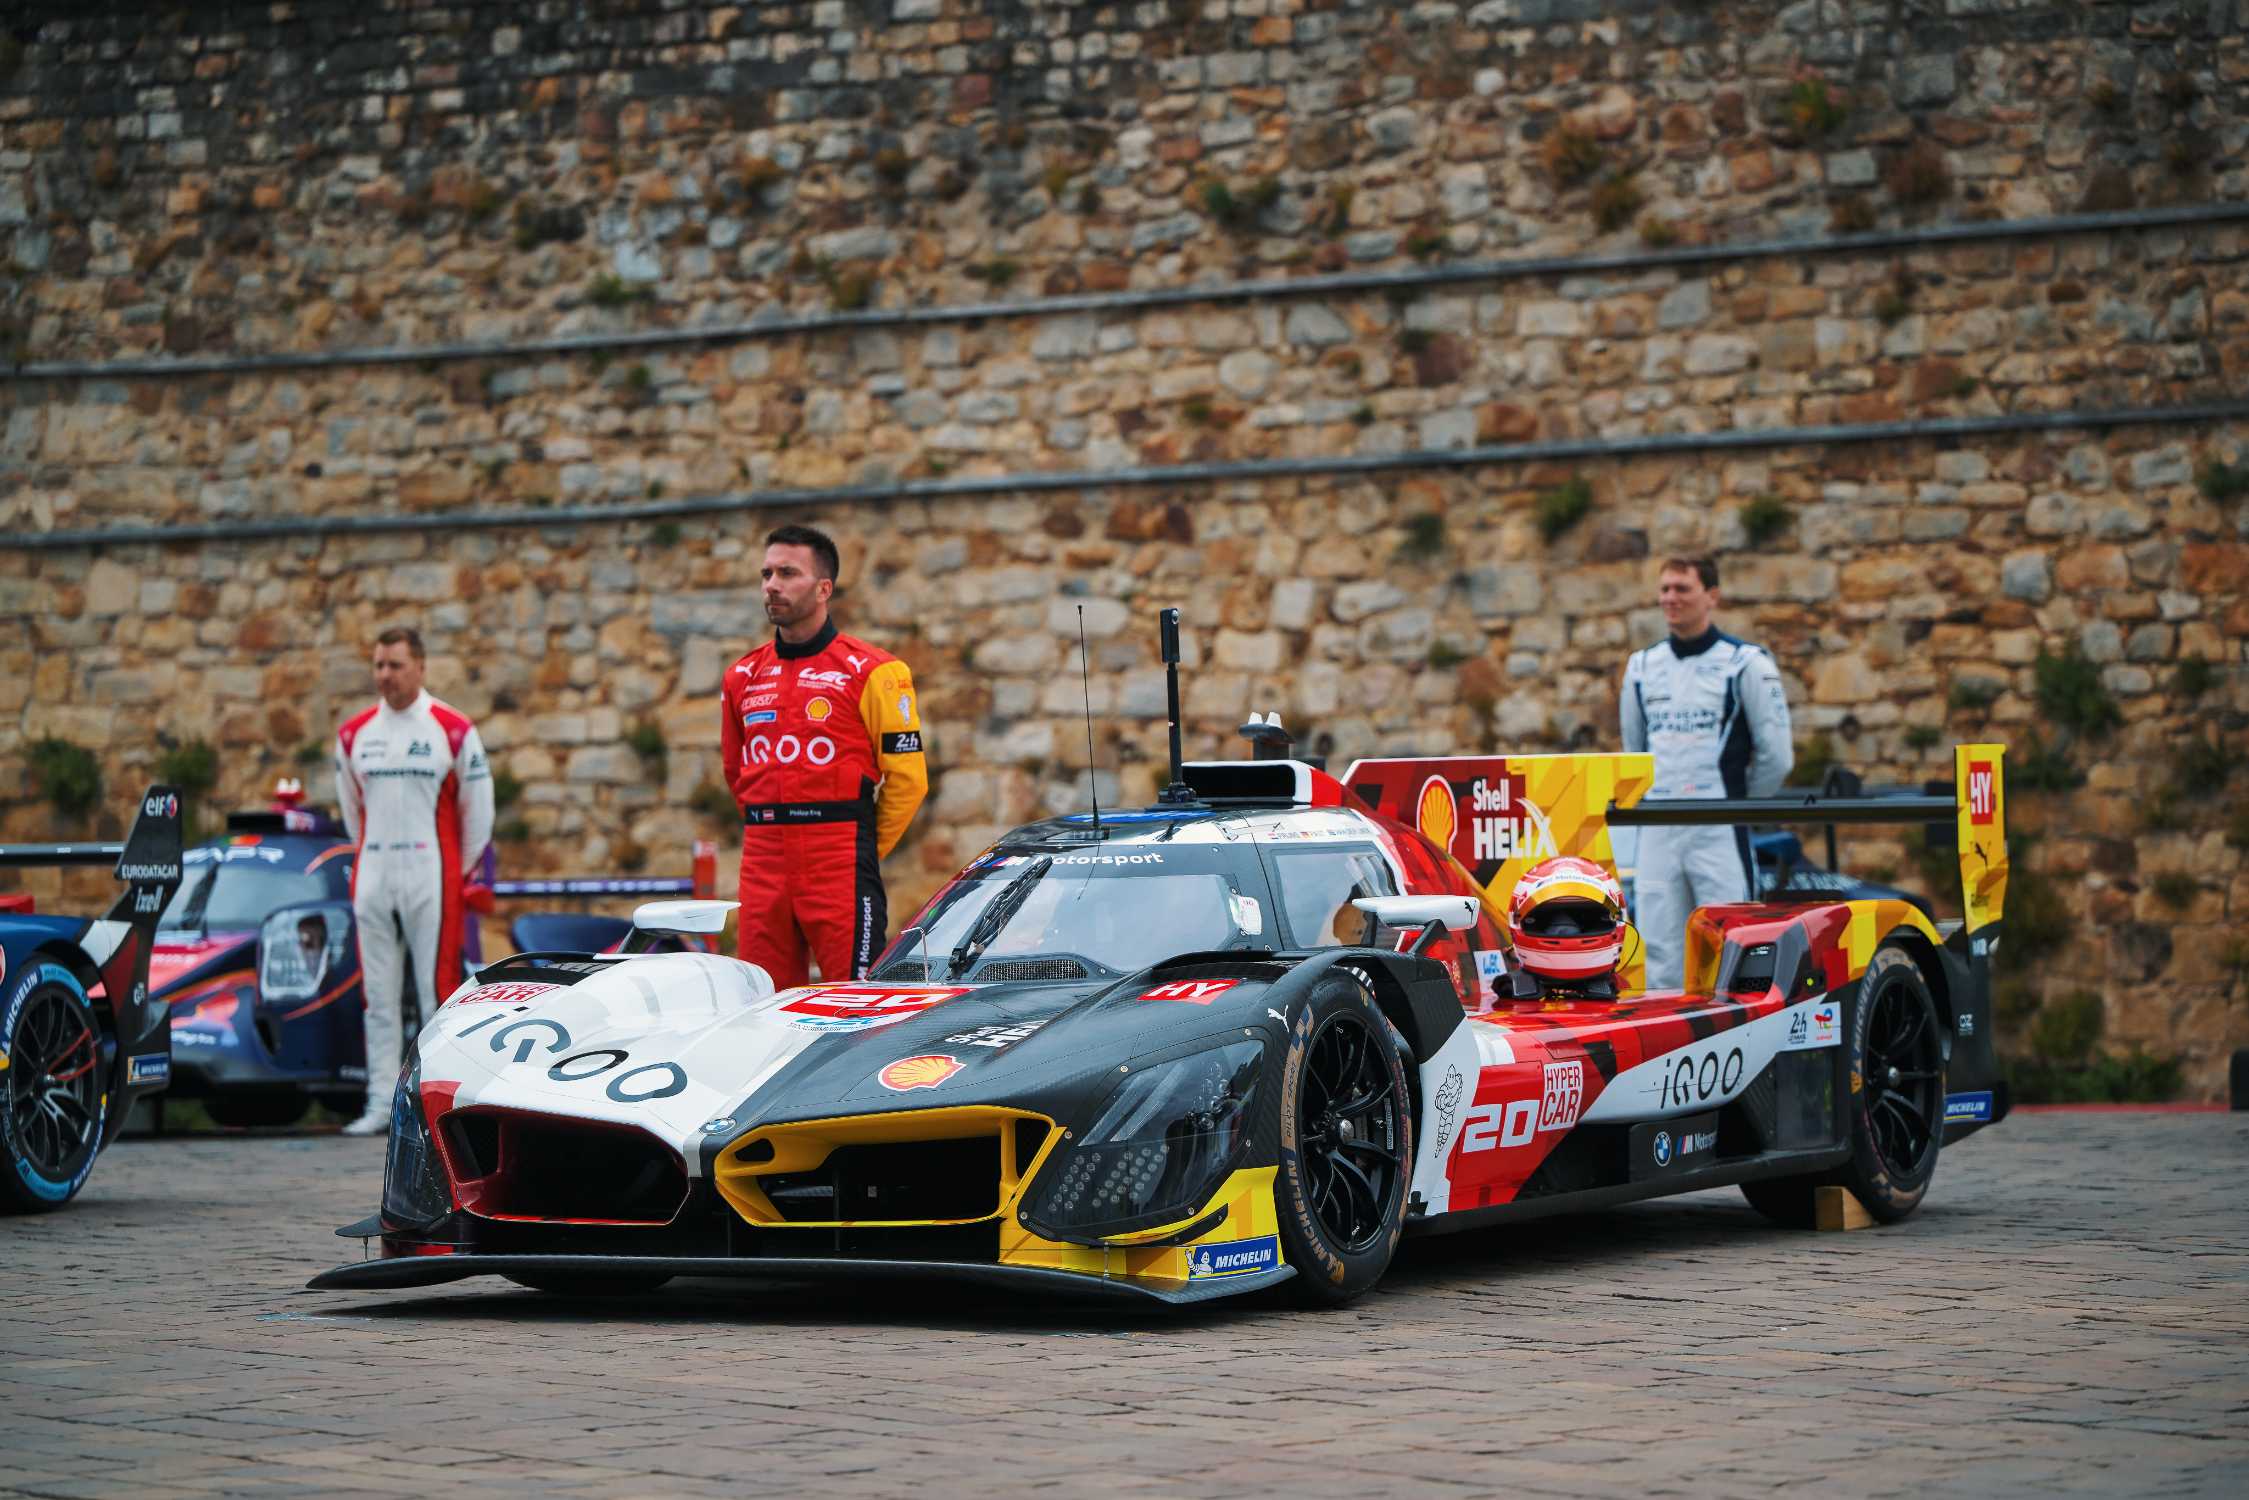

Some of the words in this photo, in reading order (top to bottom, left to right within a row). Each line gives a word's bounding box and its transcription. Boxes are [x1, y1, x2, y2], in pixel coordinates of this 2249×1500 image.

[145, 796, 166, 817] elf
[1472, 778, 1510, 812] Shell
[1970, 772, 1992, 815] HY
[1472, 813, 1560, 860] HELIX
[859, 895, 873, 963] Motorsport
[4, 971, 38, 1039] MICHELIN
[458, 990, 535, 1003] CAR
[1147, 982, 1230, 997] HY
[1546, 1066, 1581, 1091] HYPER
[1542, 1089, 1579, 1126] CAR
[1462, 1100, 1540, 1153] 20
[1215, 1249, 1272, 1268] MICHELIN
